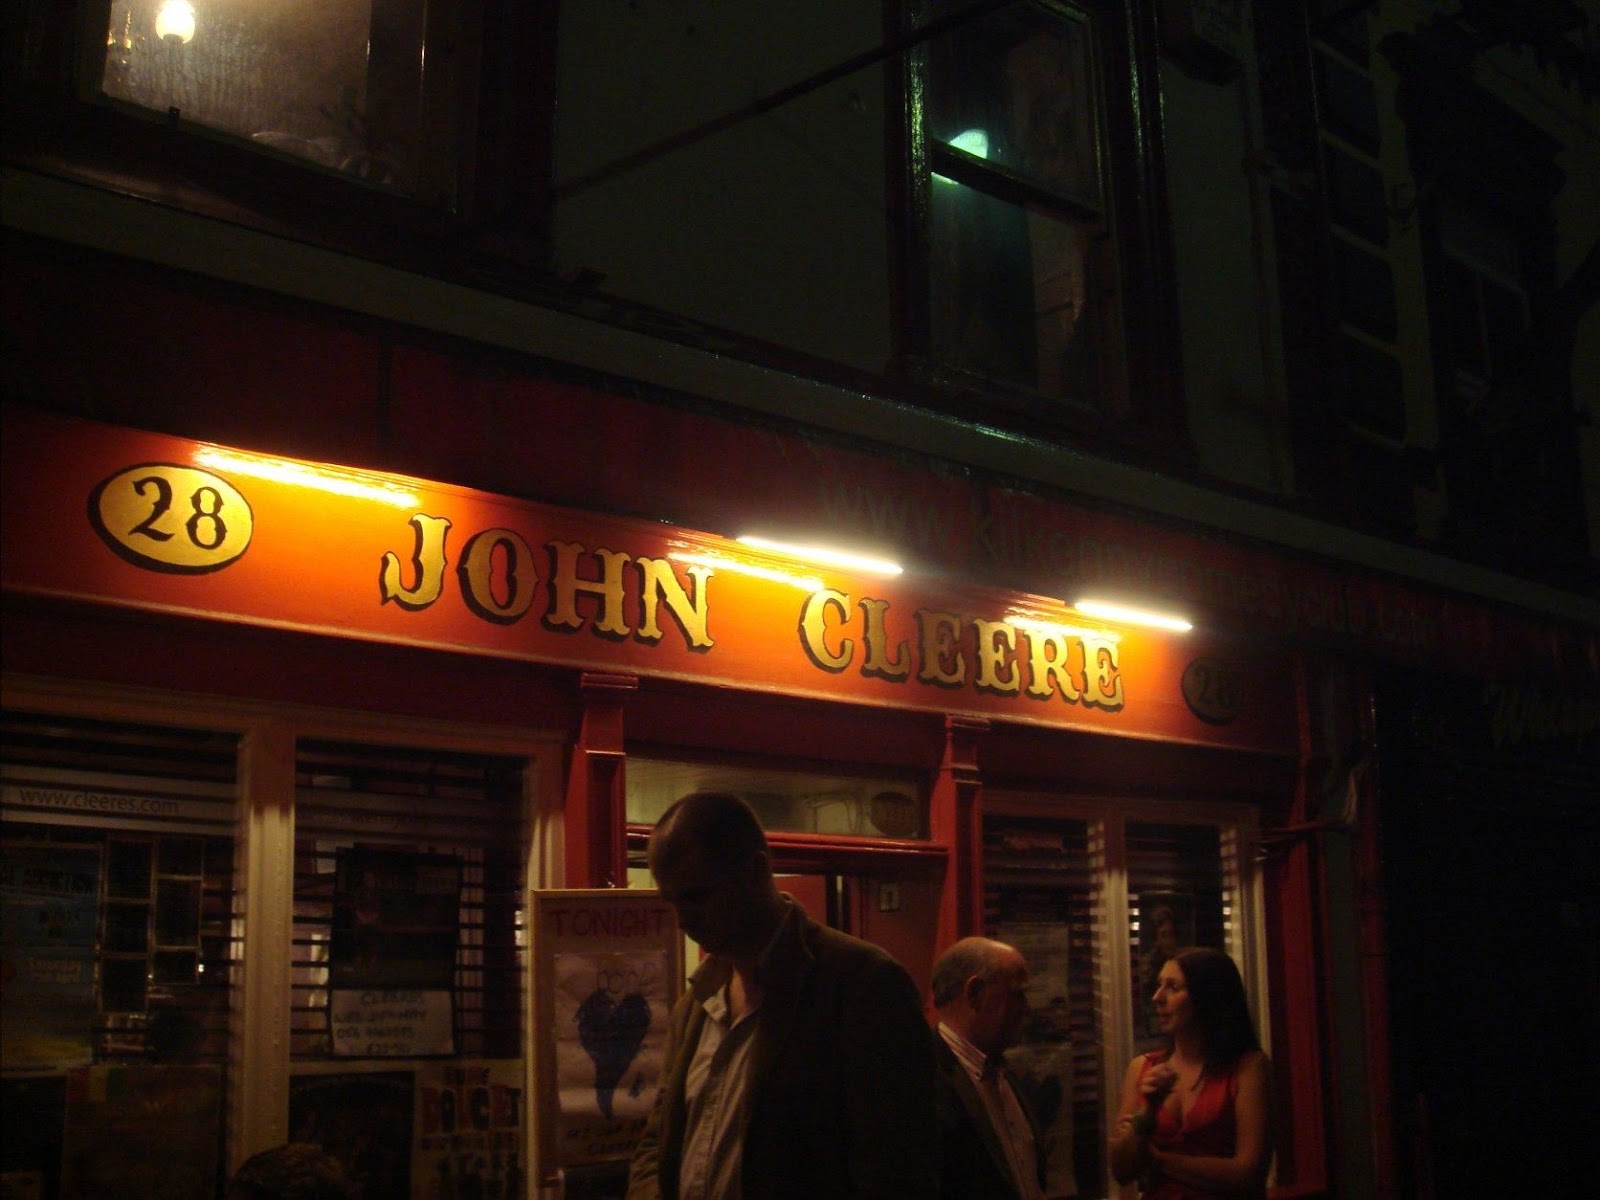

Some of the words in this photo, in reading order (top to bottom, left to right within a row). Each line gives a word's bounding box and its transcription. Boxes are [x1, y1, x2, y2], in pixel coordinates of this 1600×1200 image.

[129, 475, 228, 549] 28
[380, 513, 716, 651] JOHN
[798, 588, 1125, 713] CLEERE
[19, 787, 179, 814] www.cleeres.com
[547, 908, 668, 937] TONIGHT
